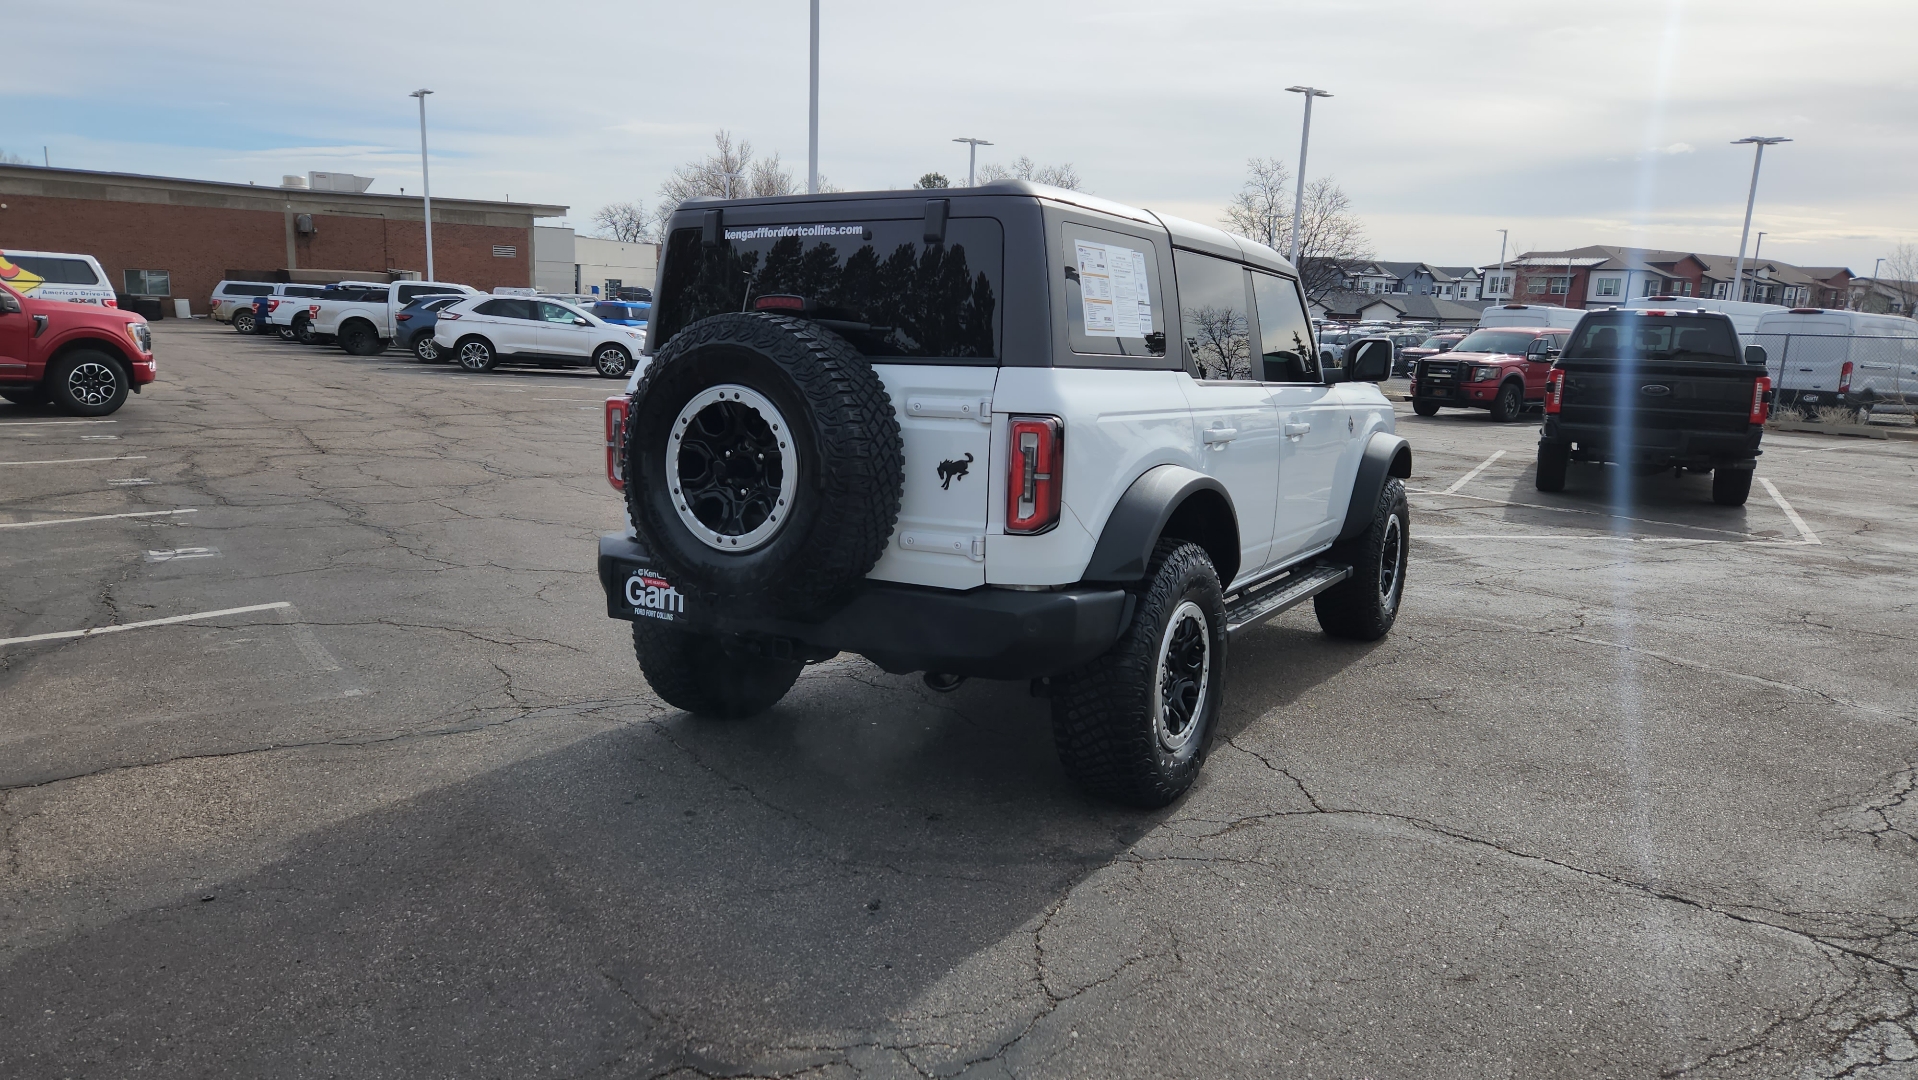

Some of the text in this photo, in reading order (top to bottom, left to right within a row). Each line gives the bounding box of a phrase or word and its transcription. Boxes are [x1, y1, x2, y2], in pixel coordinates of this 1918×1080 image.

[724, 225, 863, 241] kengarfffordfortcollins.com
[634, 608, 674, 621] FORD FORT COLLINS
